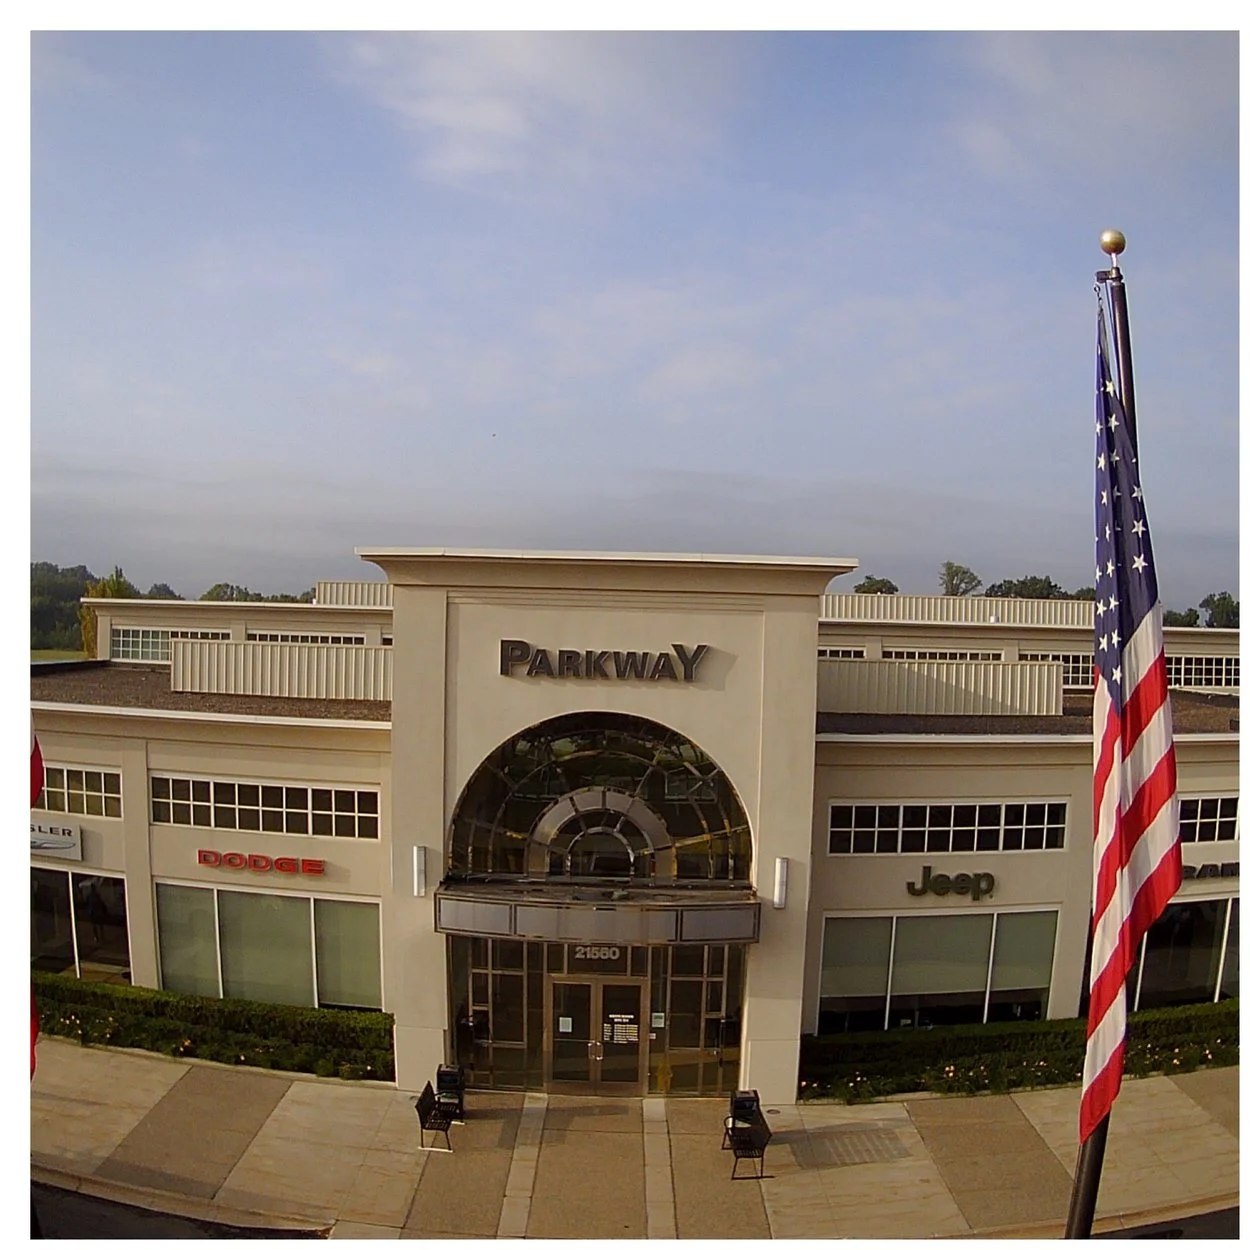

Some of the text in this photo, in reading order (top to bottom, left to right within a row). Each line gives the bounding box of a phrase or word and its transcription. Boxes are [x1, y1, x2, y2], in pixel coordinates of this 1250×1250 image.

[500, 639, 709, 682] PARKWAY
[197, 849, 325, 875] DODGE
[906, 865, 995, 901] Jeep
[575, 946, 621, 960] 21560
